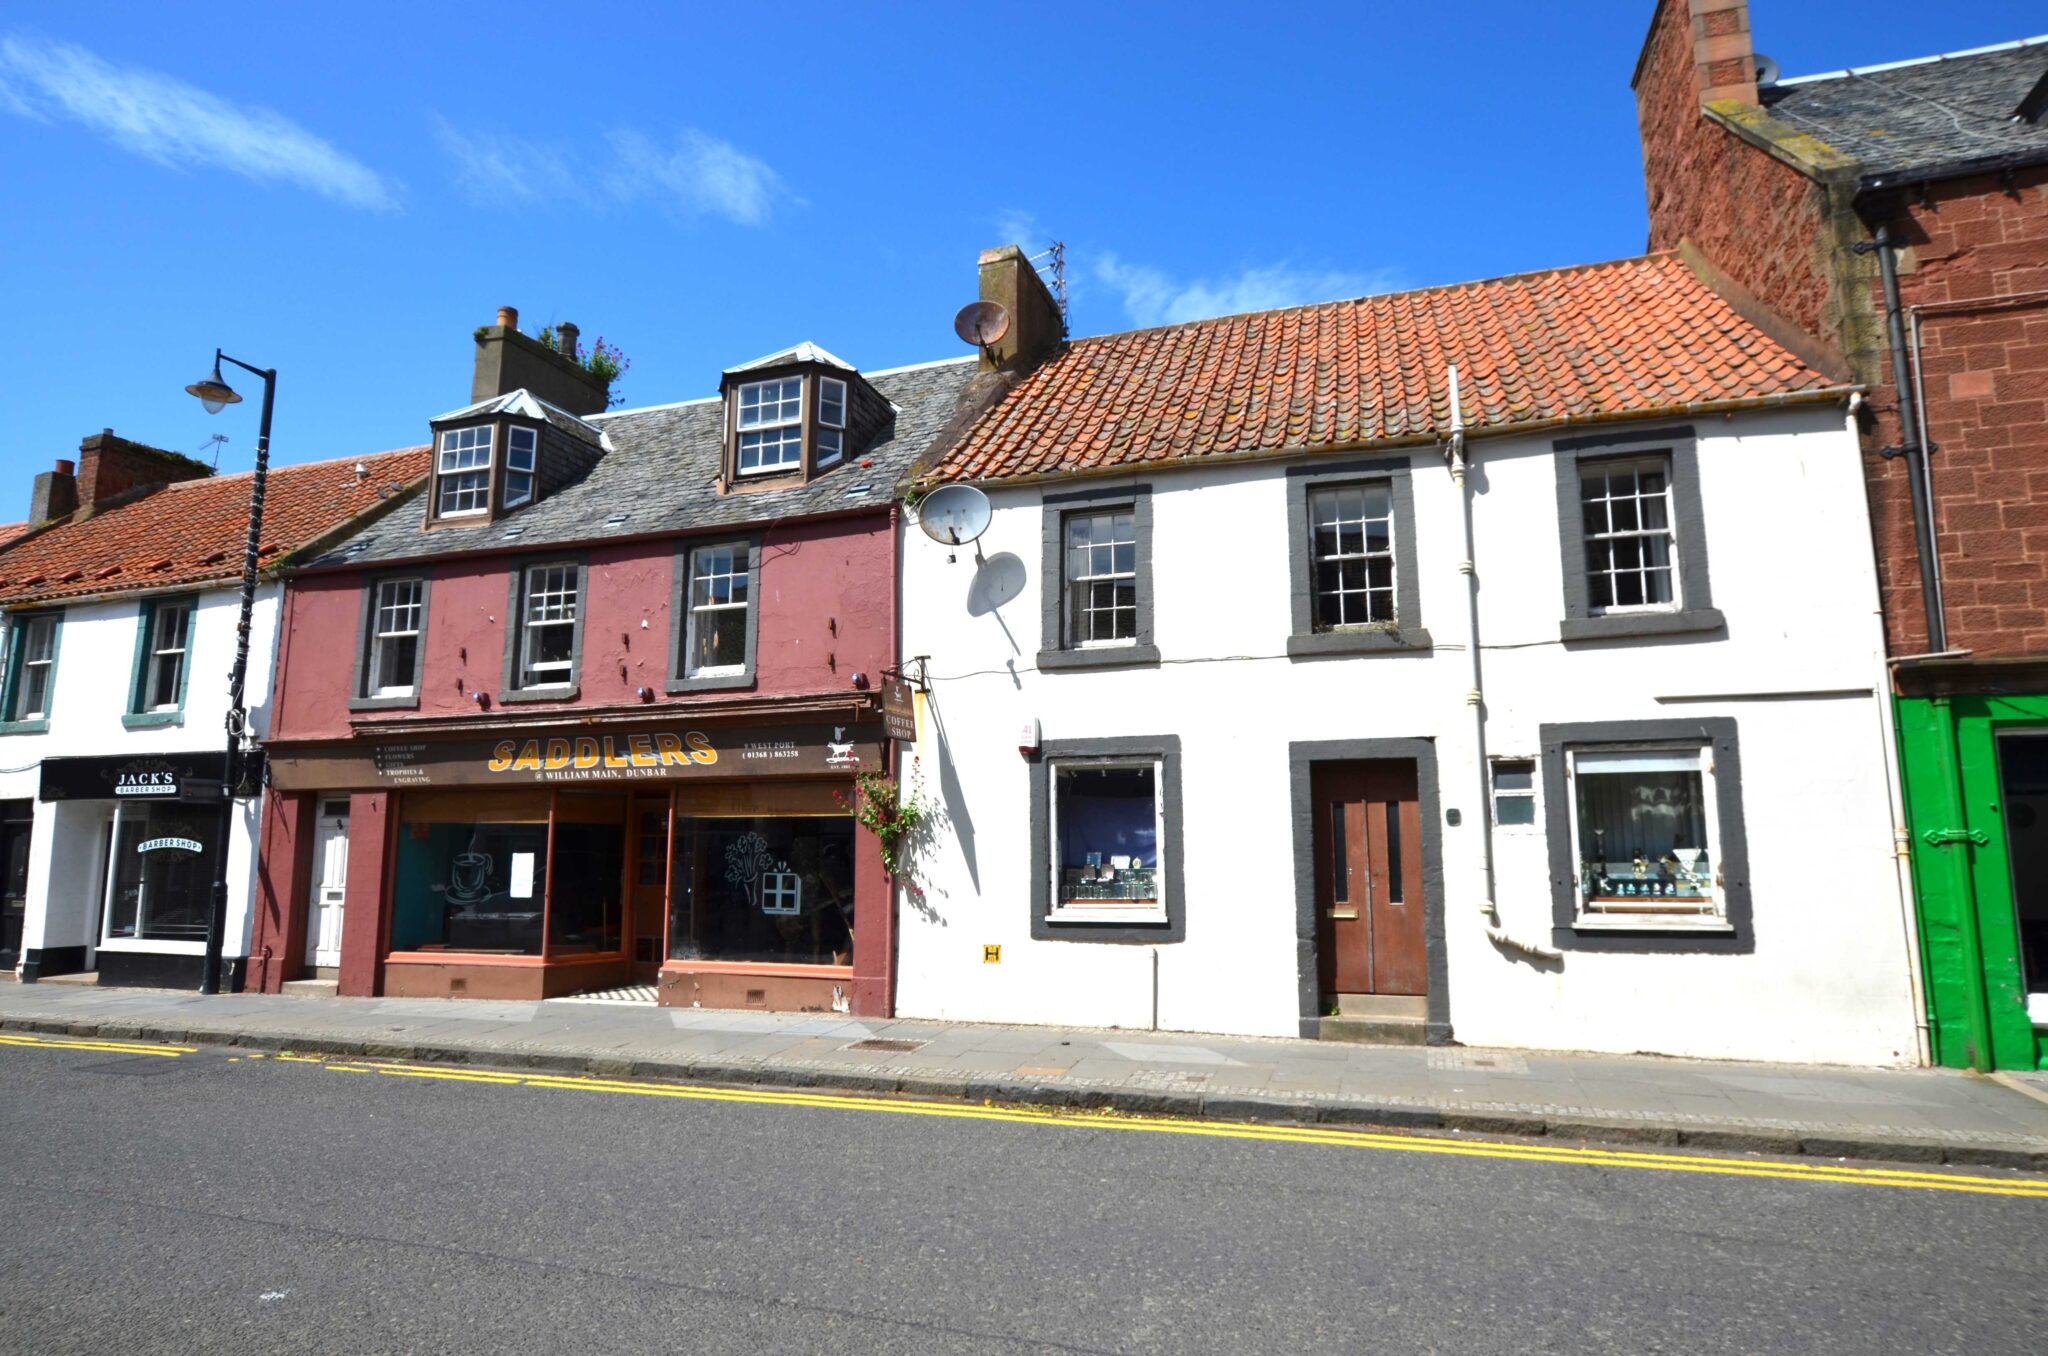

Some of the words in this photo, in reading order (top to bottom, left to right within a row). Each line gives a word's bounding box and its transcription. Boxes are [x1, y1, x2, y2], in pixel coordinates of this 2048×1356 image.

[886, 715, 914, 729] COFFEE
[891, 727, 911, 739] SHOP
[488, 731, 718, 772] SADDLERS
[750, 742, 772, 750] WEST
[774, 741, 795, 749] PORT
[774, 750, 799, 758] 863258
[118, 772, 173, 785] JACK'S
[545, 770, 589, 780] WILLIAM
[592, 769, 621, 778] MAIN,
[626, 768, 667, 778] DUNBAR
[143, 839, 174, 850] BARBER
[176, 839, 198, 849] SHOP
